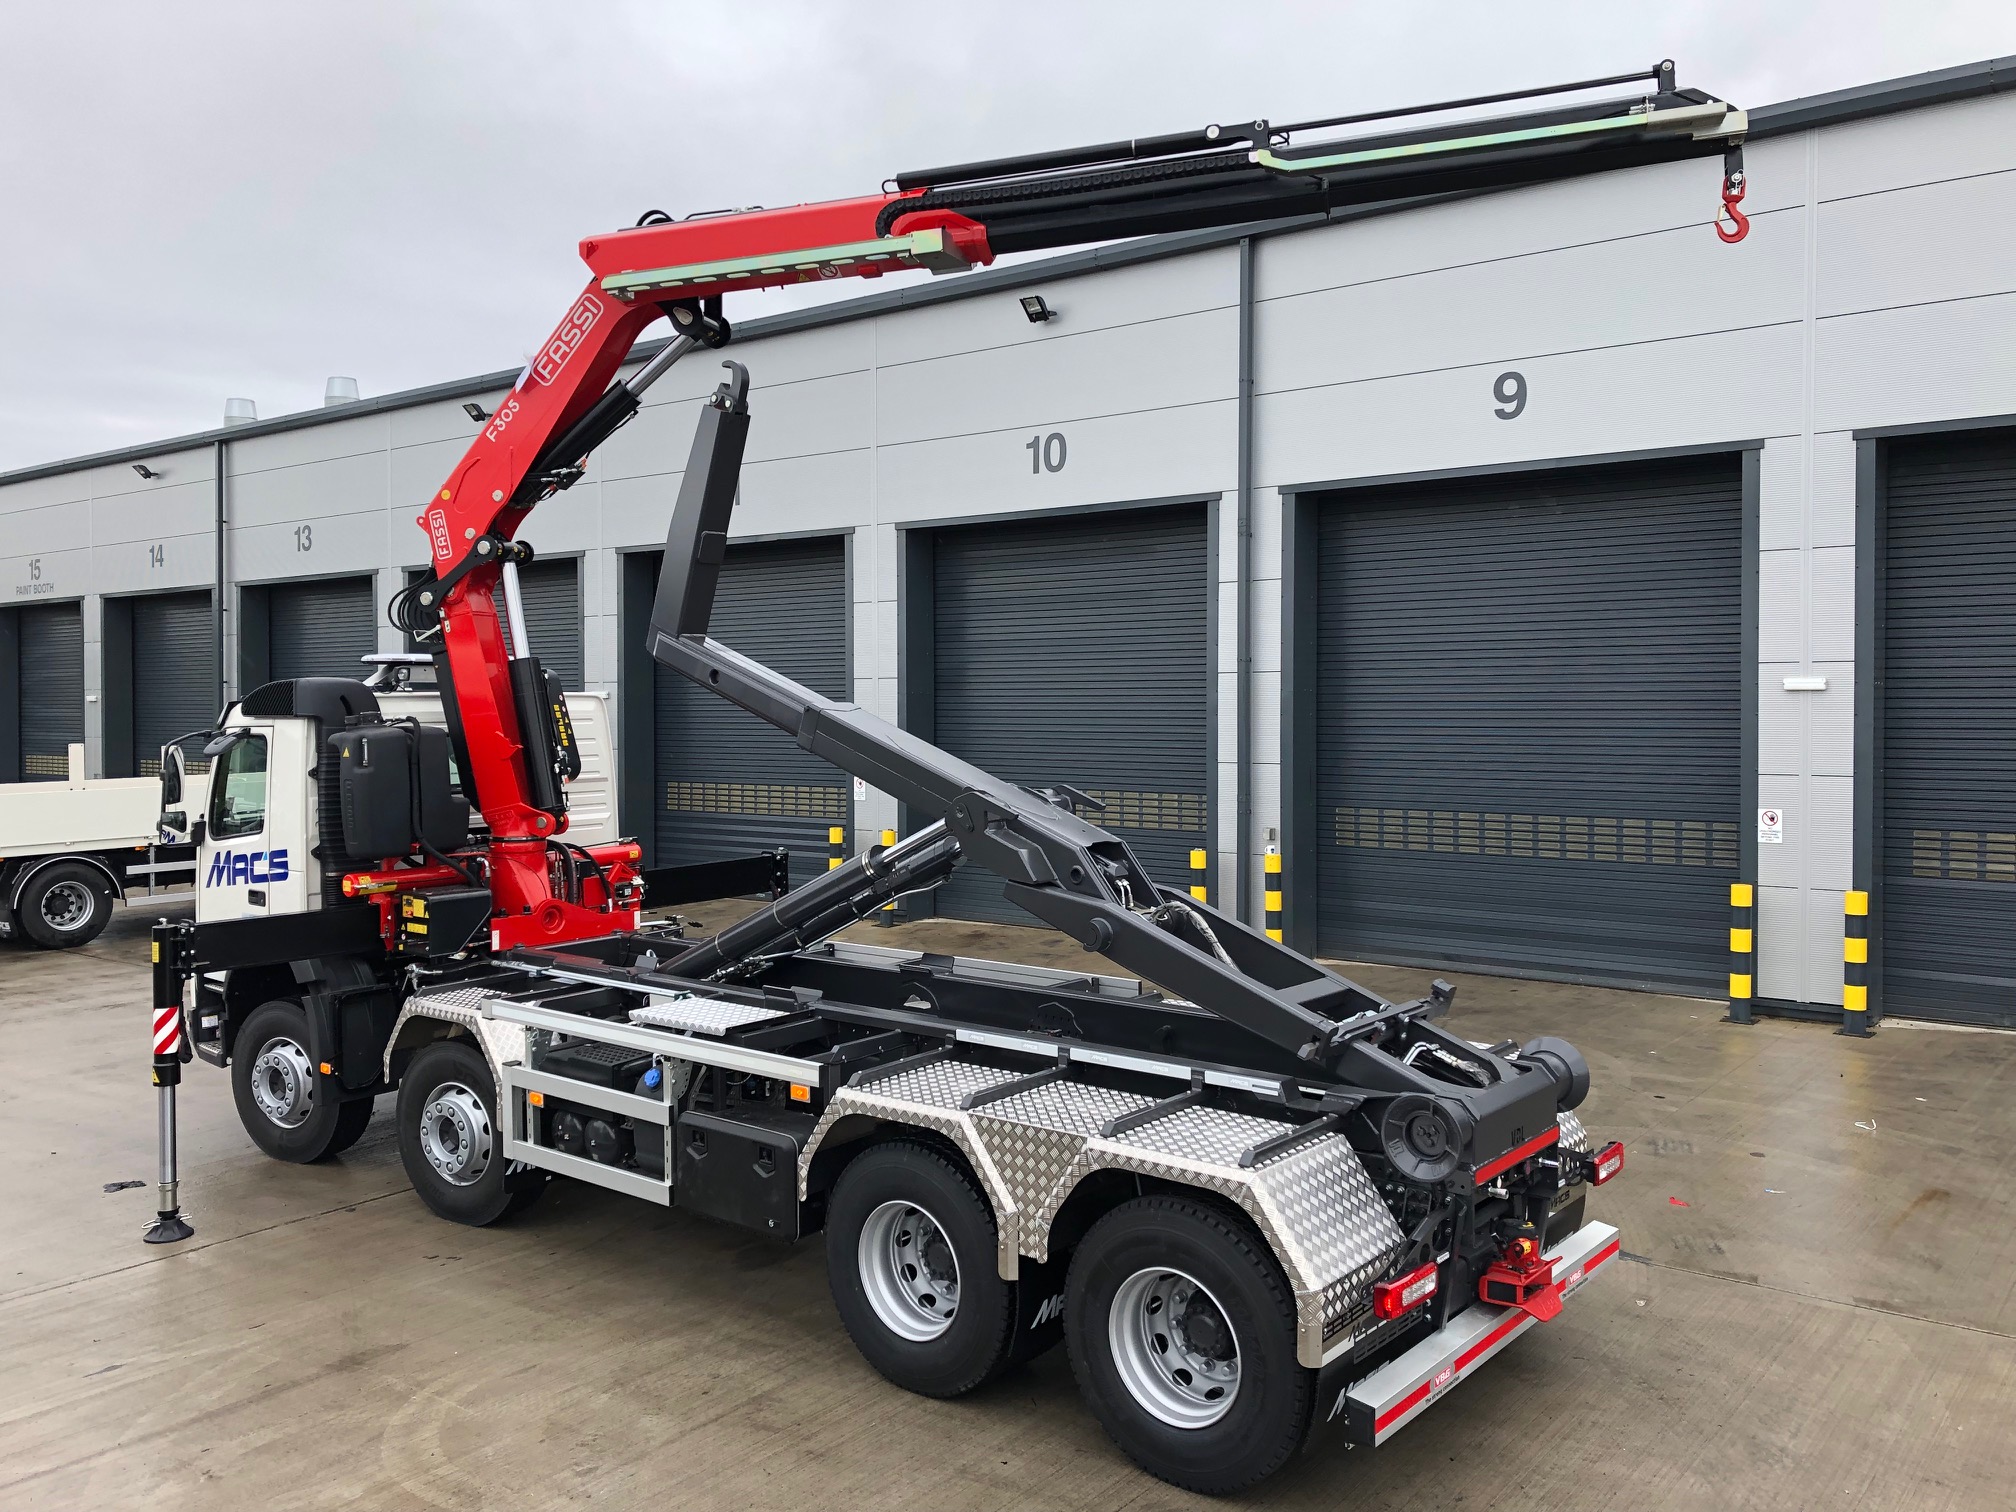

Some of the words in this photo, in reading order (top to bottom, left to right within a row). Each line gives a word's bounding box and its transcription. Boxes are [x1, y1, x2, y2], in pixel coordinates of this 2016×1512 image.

[536, 300, 599, 379] FASSI
[1492, 371, 1528, 421] 9
[485, 398, 520, 443] F305
[1025, 432, 1068, 475] 10
[293, 524, 312, 552] 13
[432, 513, 449, 556] FASSI
[28, 559, 41, 581] 15
[149, 544, 164, 568] 14
[16, 584, 32, 596] PAINT
[33, 582, 54, 595] BOOTH
[1435, 1368, 1451, 1386] VBG
